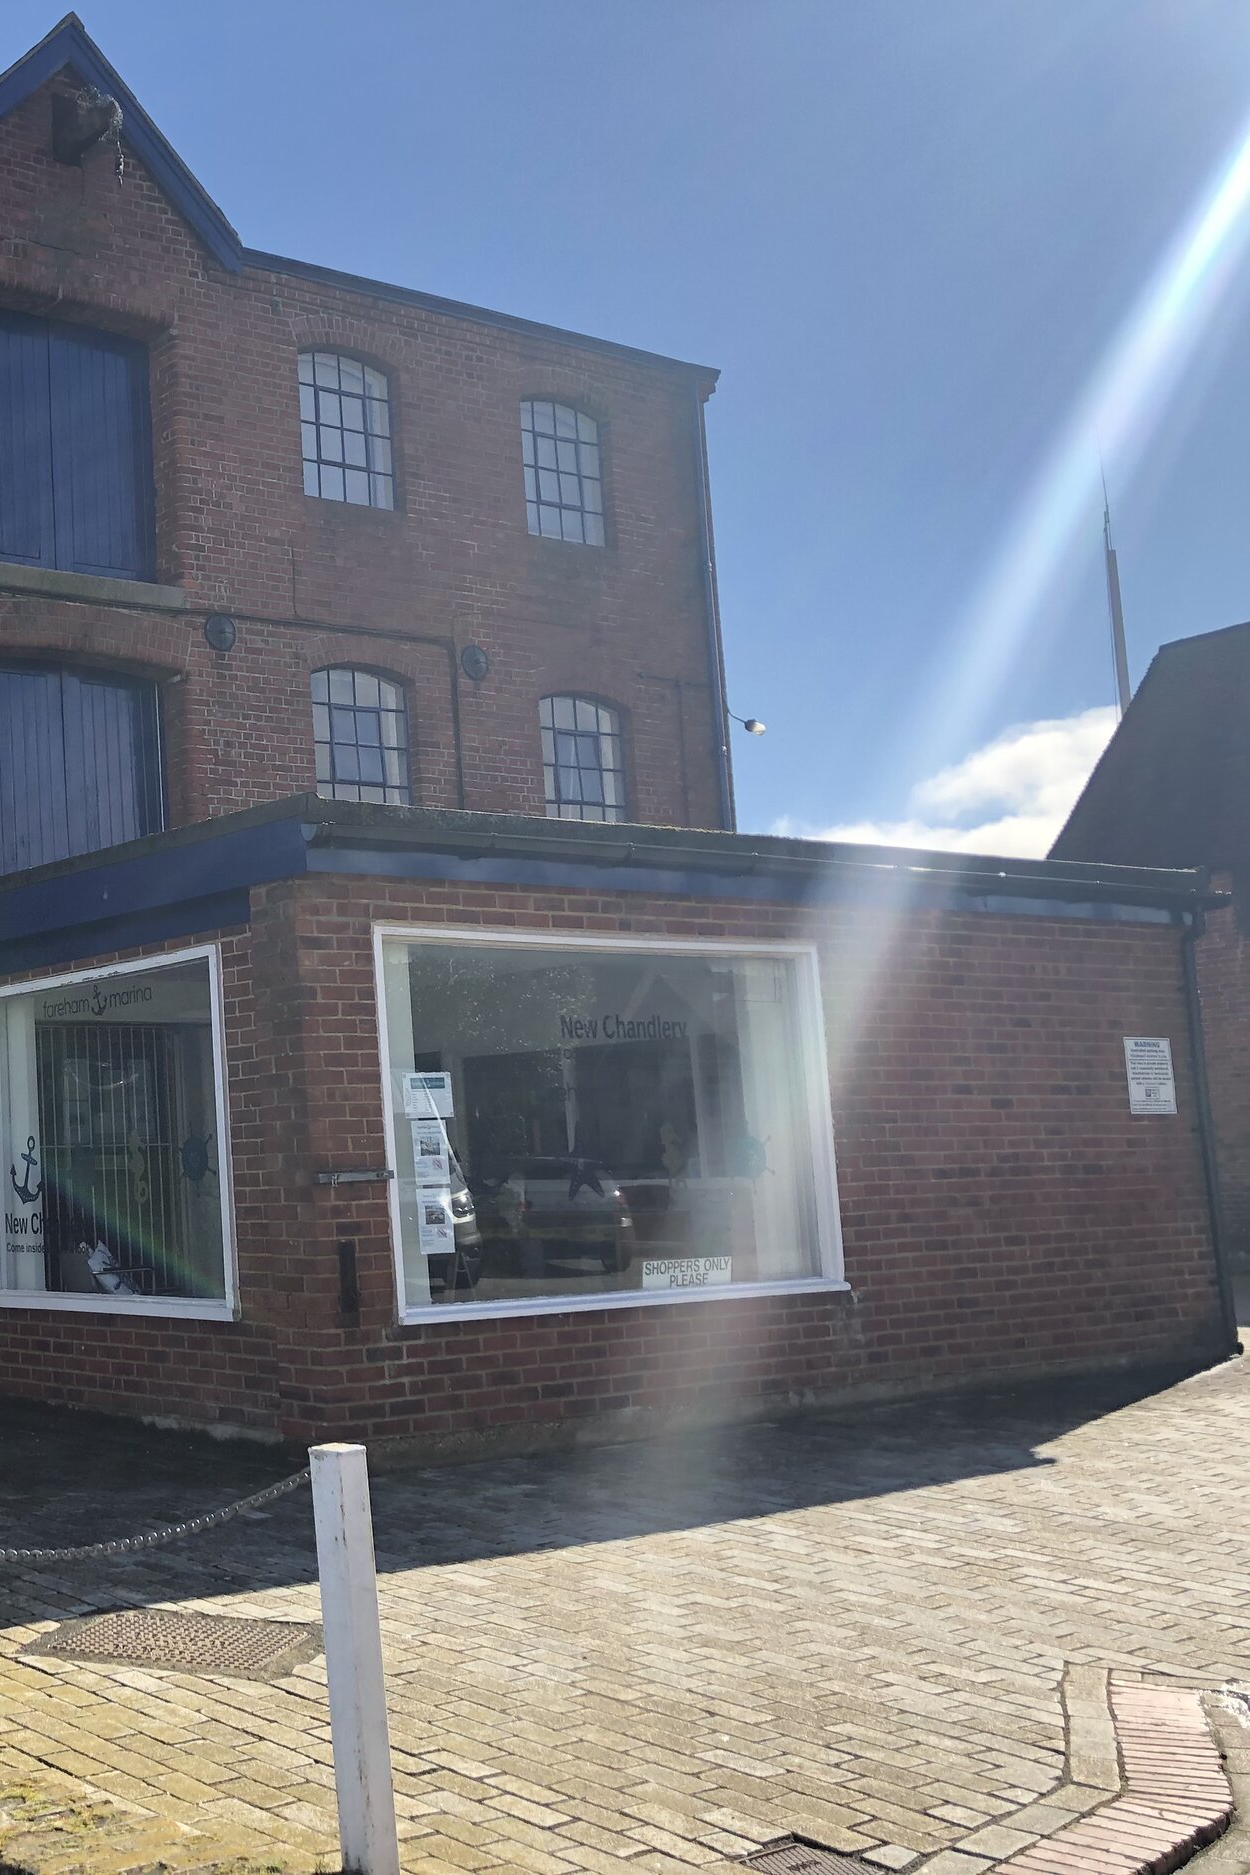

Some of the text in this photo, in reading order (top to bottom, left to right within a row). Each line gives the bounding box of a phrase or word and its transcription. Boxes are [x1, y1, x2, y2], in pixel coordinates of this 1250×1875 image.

[43, 985, 152, 1018] fareham marina
[559, 1014, 687, 1040] New Chandlery
[5, 1213, 28, 1234] New
[6, 1242, 25, 1253] Come
[644, 1258, 730, 1276] SHOPPERS ONLY
[670, 1273, 709, 1288] PLEASE
